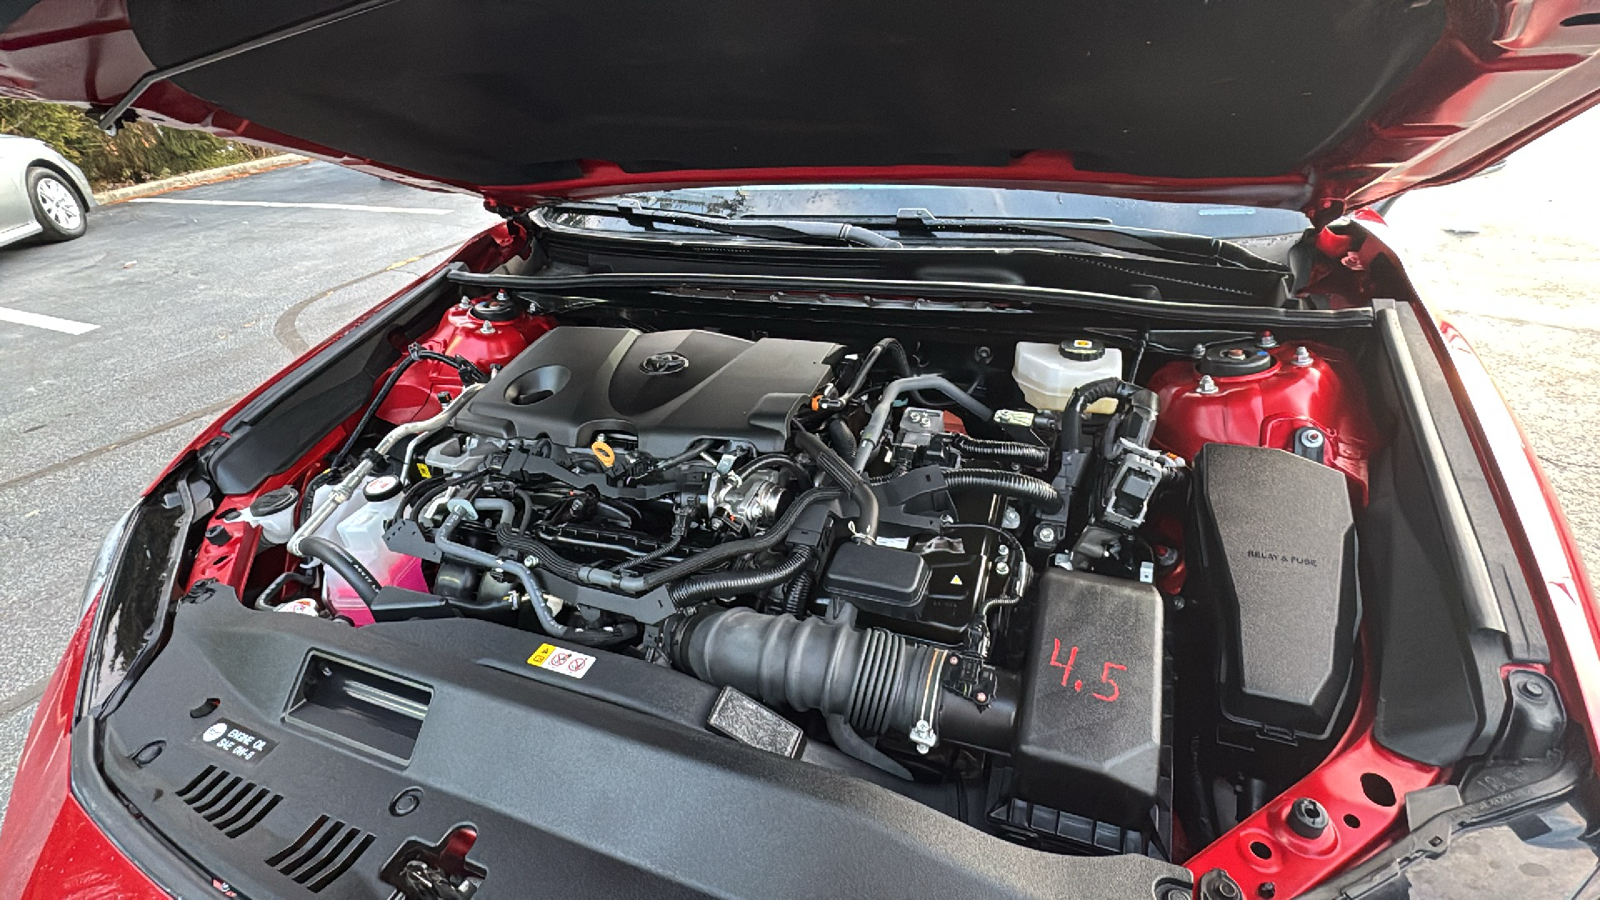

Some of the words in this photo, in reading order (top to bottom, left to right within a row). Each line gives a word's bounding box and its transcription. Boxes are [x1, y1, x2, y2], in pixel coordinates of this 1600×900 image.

[1247, 550, 1278, 561] RELAY
[1281, 555, 1288, 563] &
[1290, 555, 1318, 568] FUSE
[1049, 637, 1128, 702] 4.5
[216, 738, 236, 751] SAE
[227, 728, 256, 746] ENGINE
[252, 739, 267, 752] OIL
